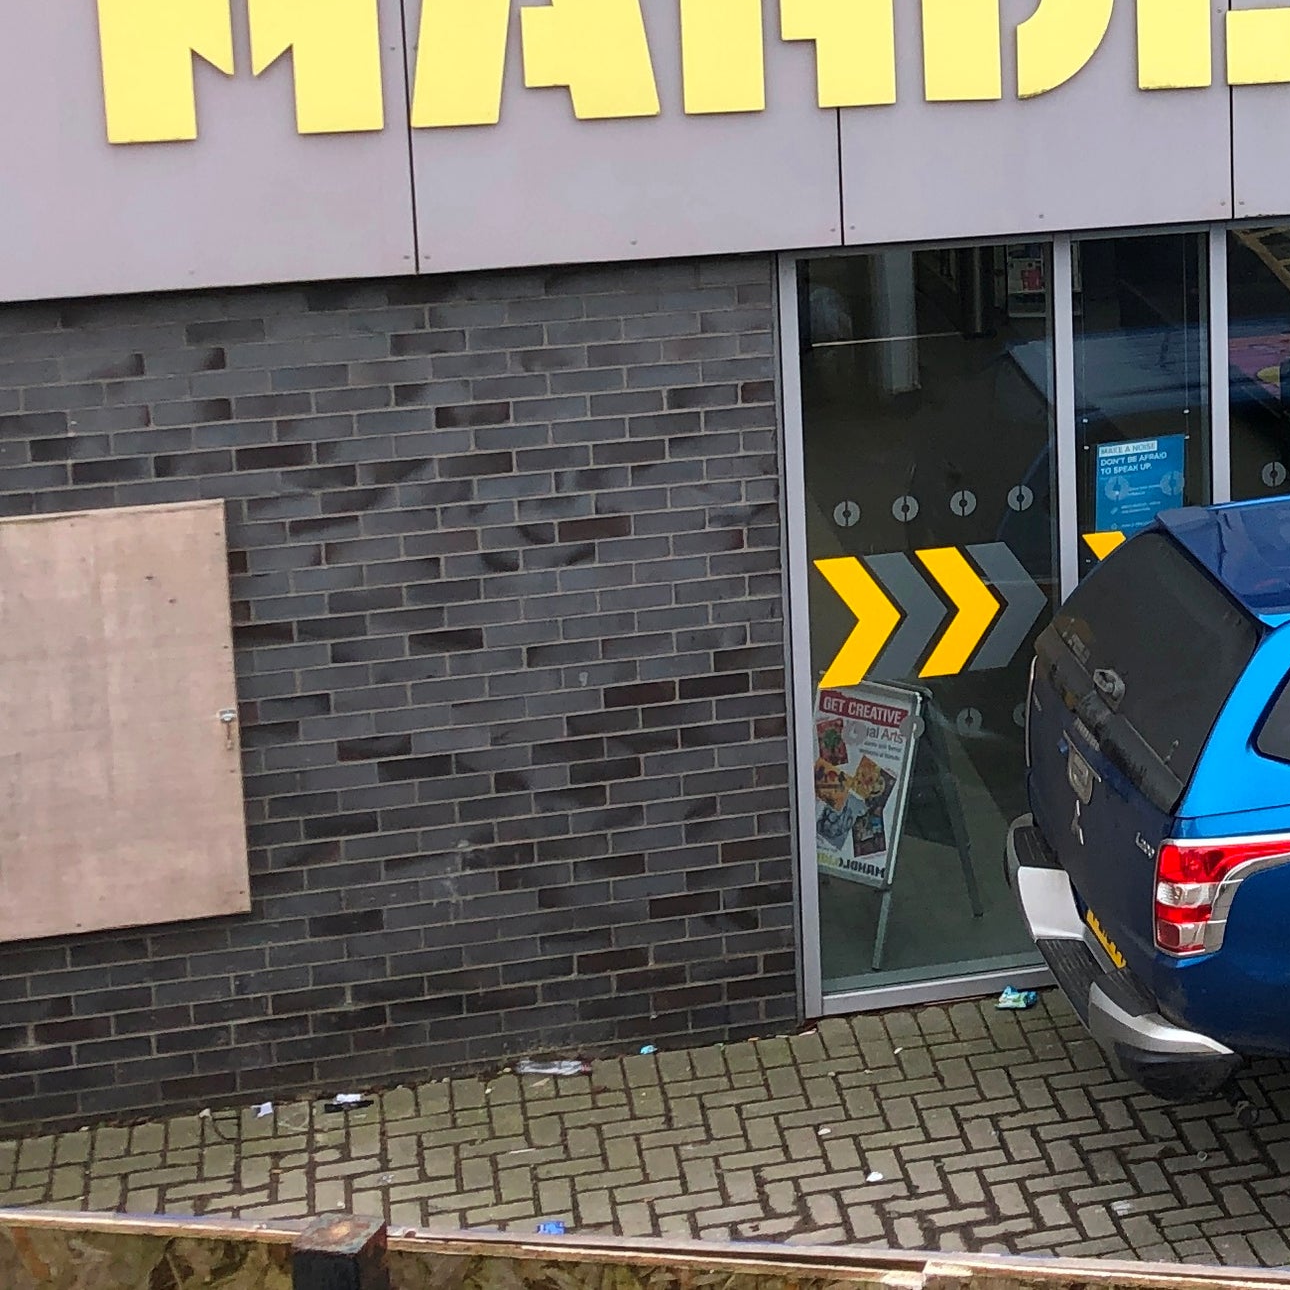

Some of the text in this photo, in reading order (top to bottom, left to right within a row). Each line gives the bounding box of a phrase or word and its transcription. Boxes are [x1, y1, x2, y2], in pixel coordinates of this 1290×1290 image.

[1138, 451, 1168, 462] AFRAID
[1113, 463, 1139, 474] SPEAK
[823, 696, 902, 725] GET CREATIVE
[881, 728, 904, 744] Arts
